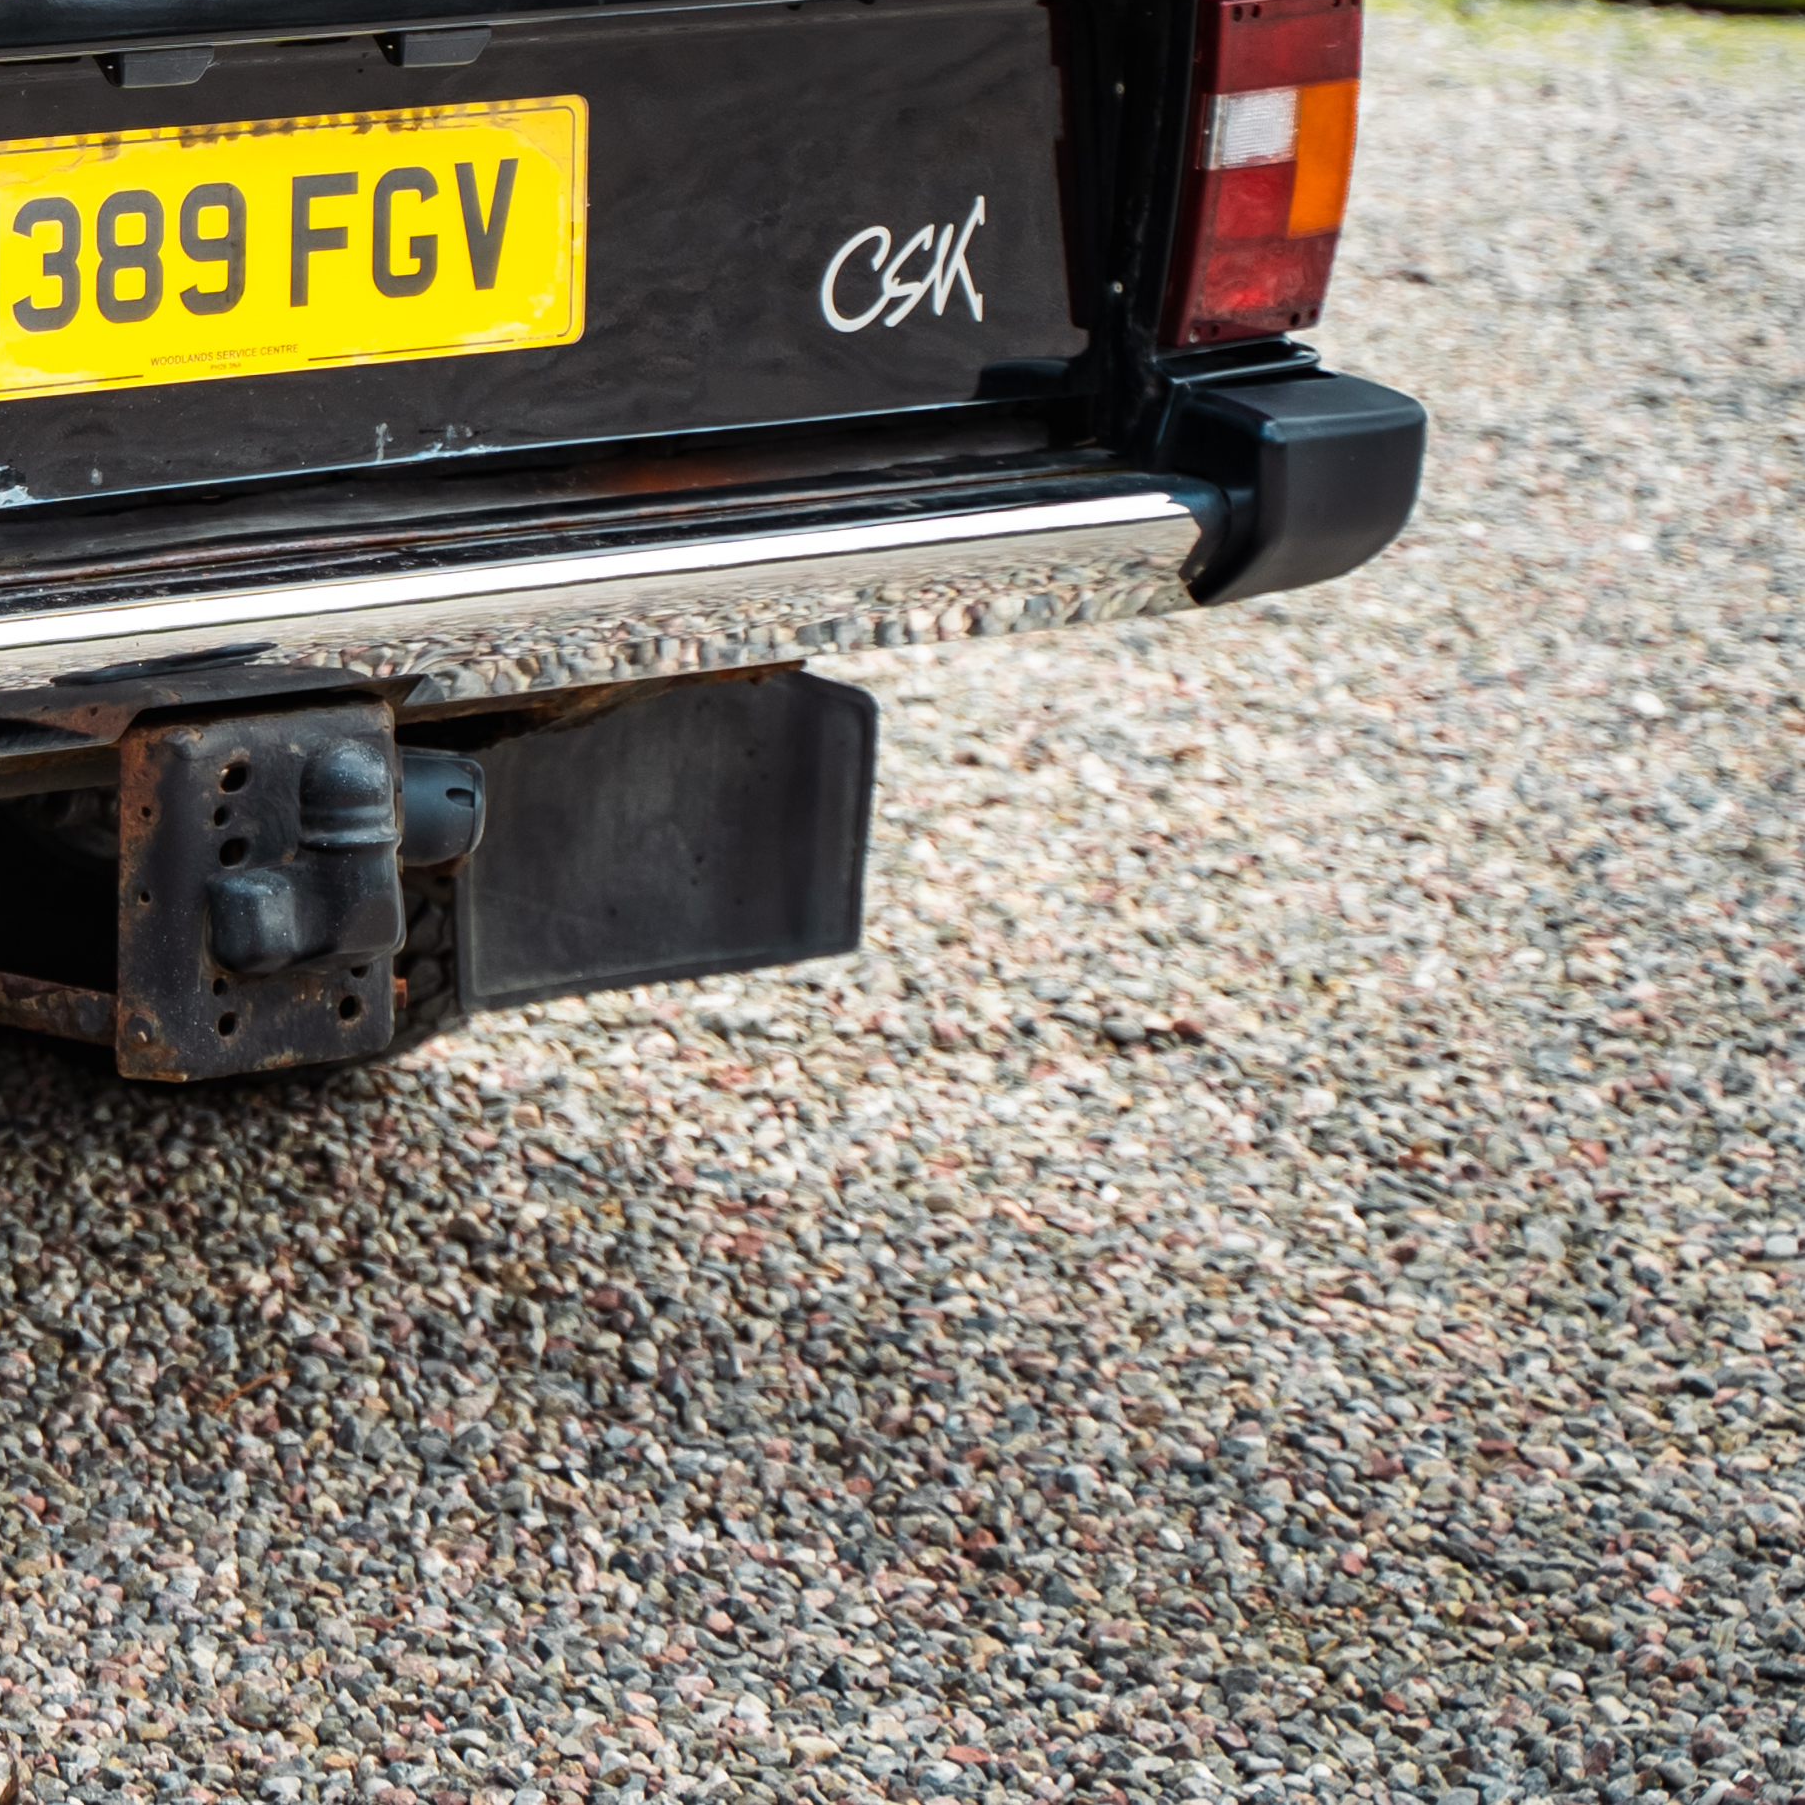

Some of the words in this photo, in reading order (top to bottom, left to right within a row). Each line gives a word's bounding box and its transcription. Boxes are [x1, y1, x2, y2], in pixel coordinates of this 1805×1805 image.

[289, 157, 520, 308] FGV
[820, 194, 986, 333] CSK
[150, 351, 214, 367] WOODLANDS
[216, 347, 257, 361] SERVICE
[260, 343, 299, 356] CENTRE
